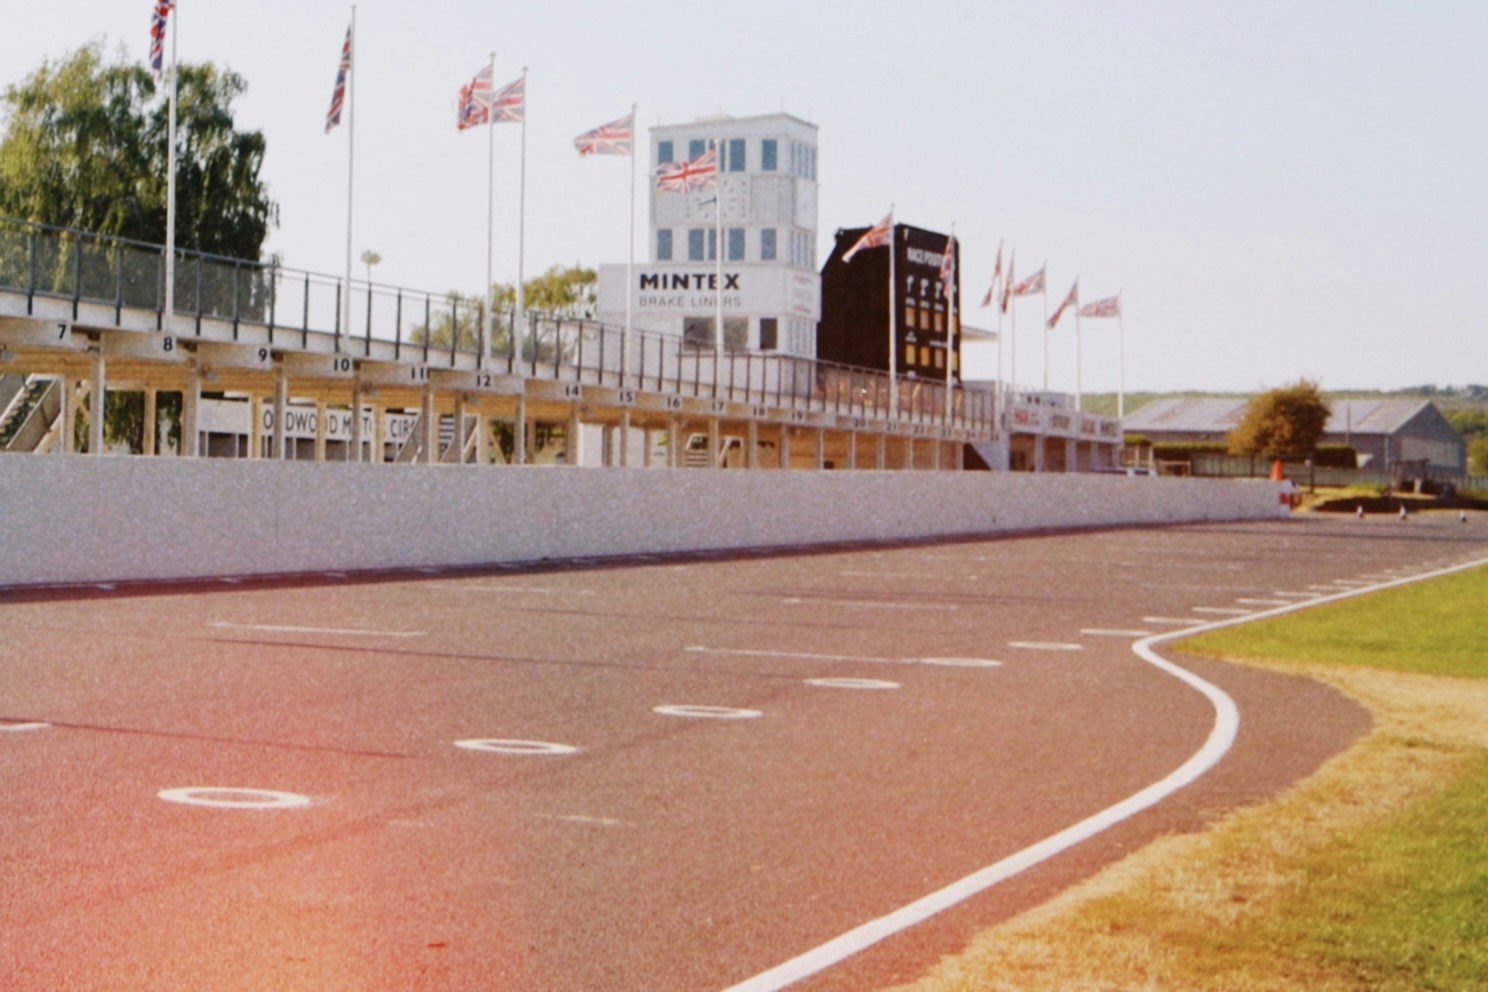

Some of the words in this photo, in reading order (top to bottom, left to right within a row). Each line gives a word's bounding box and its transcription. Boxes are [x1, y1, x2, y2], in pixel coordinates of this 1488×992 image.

[640, 273, 741, 290] MINTEX
[639, 295, 685, 307] BRAKE
[57, 324, 67, 340] 7
[163, 336, 173, 351] 8
[258, 348, 268, 362] 9
[333, 358, 350, 372] 10
[412, 366, 427, 381] 11
[476, 374, 492, 388] 12
[565, 385, 580, 397] 14
[619, 391, 633, 403] 15
[667, 397, 681, 408] 16
[712, 401, 724, 412] 17
